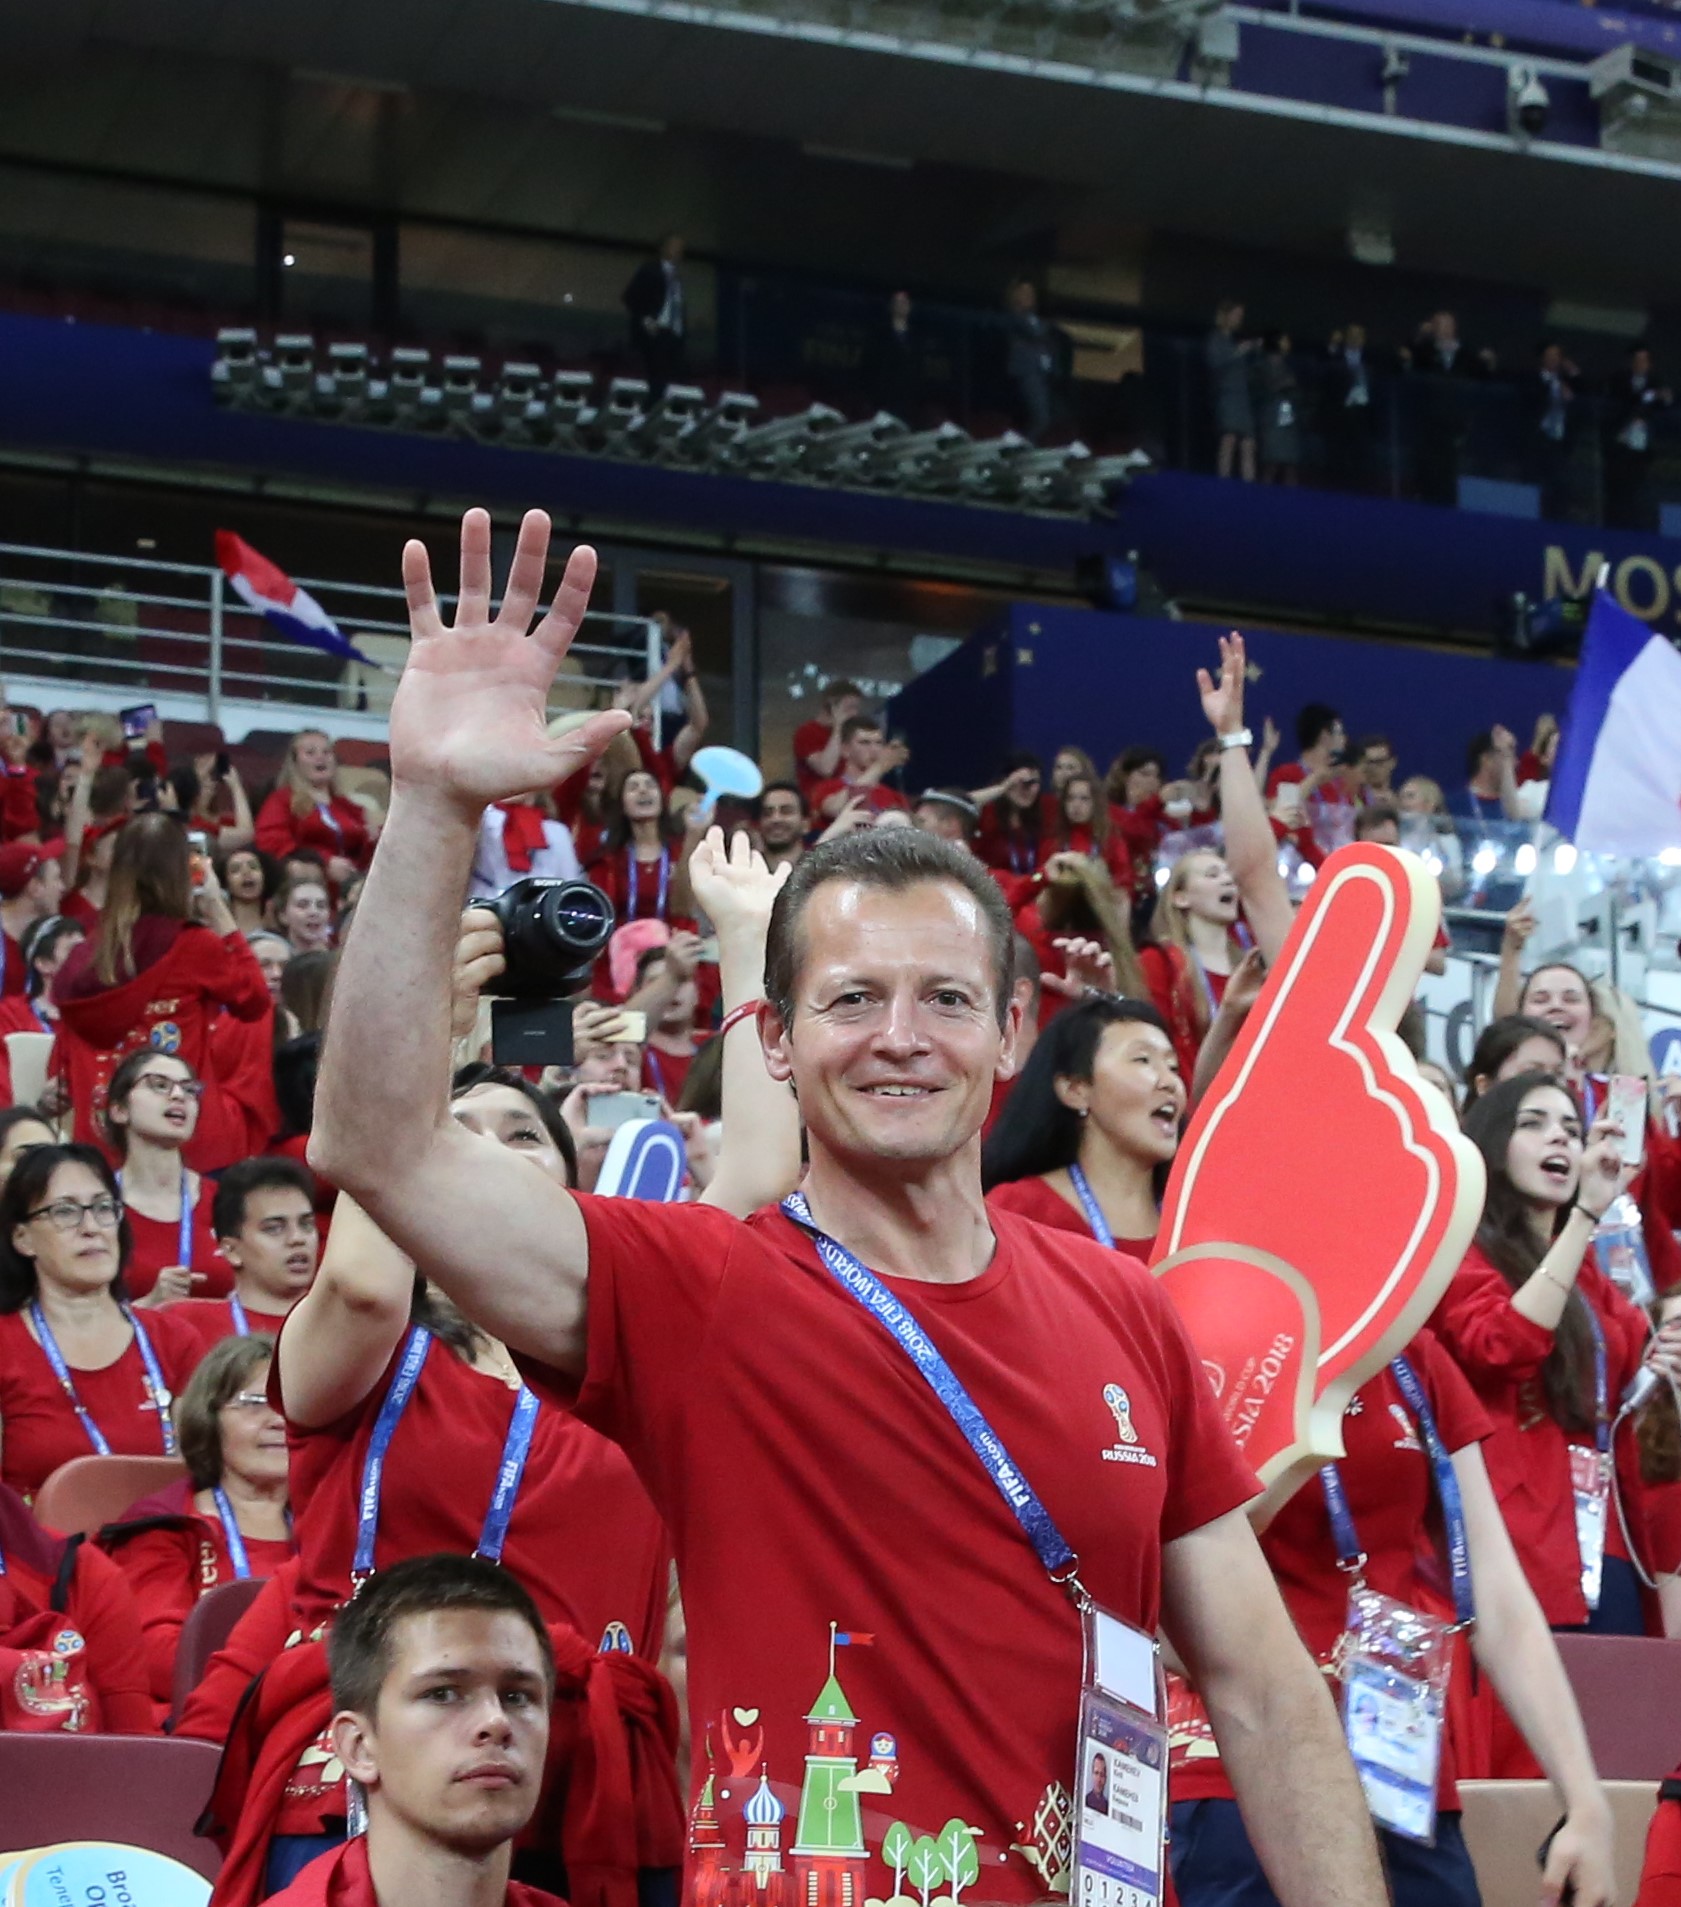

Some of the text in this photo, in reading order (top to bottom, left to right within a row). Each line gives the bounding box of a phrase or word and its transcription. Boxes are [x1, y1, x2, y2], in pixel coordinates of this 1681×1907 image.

[1543, 545, 1681, 626] MO
[825, 1244, 874, 1296] WORLD
[869, 1289, 903, 1325] FIFA
[898, 1317, 933, 1361] 2018
[1252, 1333, 1294, 1394] 2018
[979, 1431, 1030, 1508] FIFA.com
[1102, 1449, 1139, 1464] RUSSIA
[1085, 1874, 1093, 1892] 0
[1102, 1881, 1107, 1899] 1
[1116, 1887, 1124, 1905] 2
